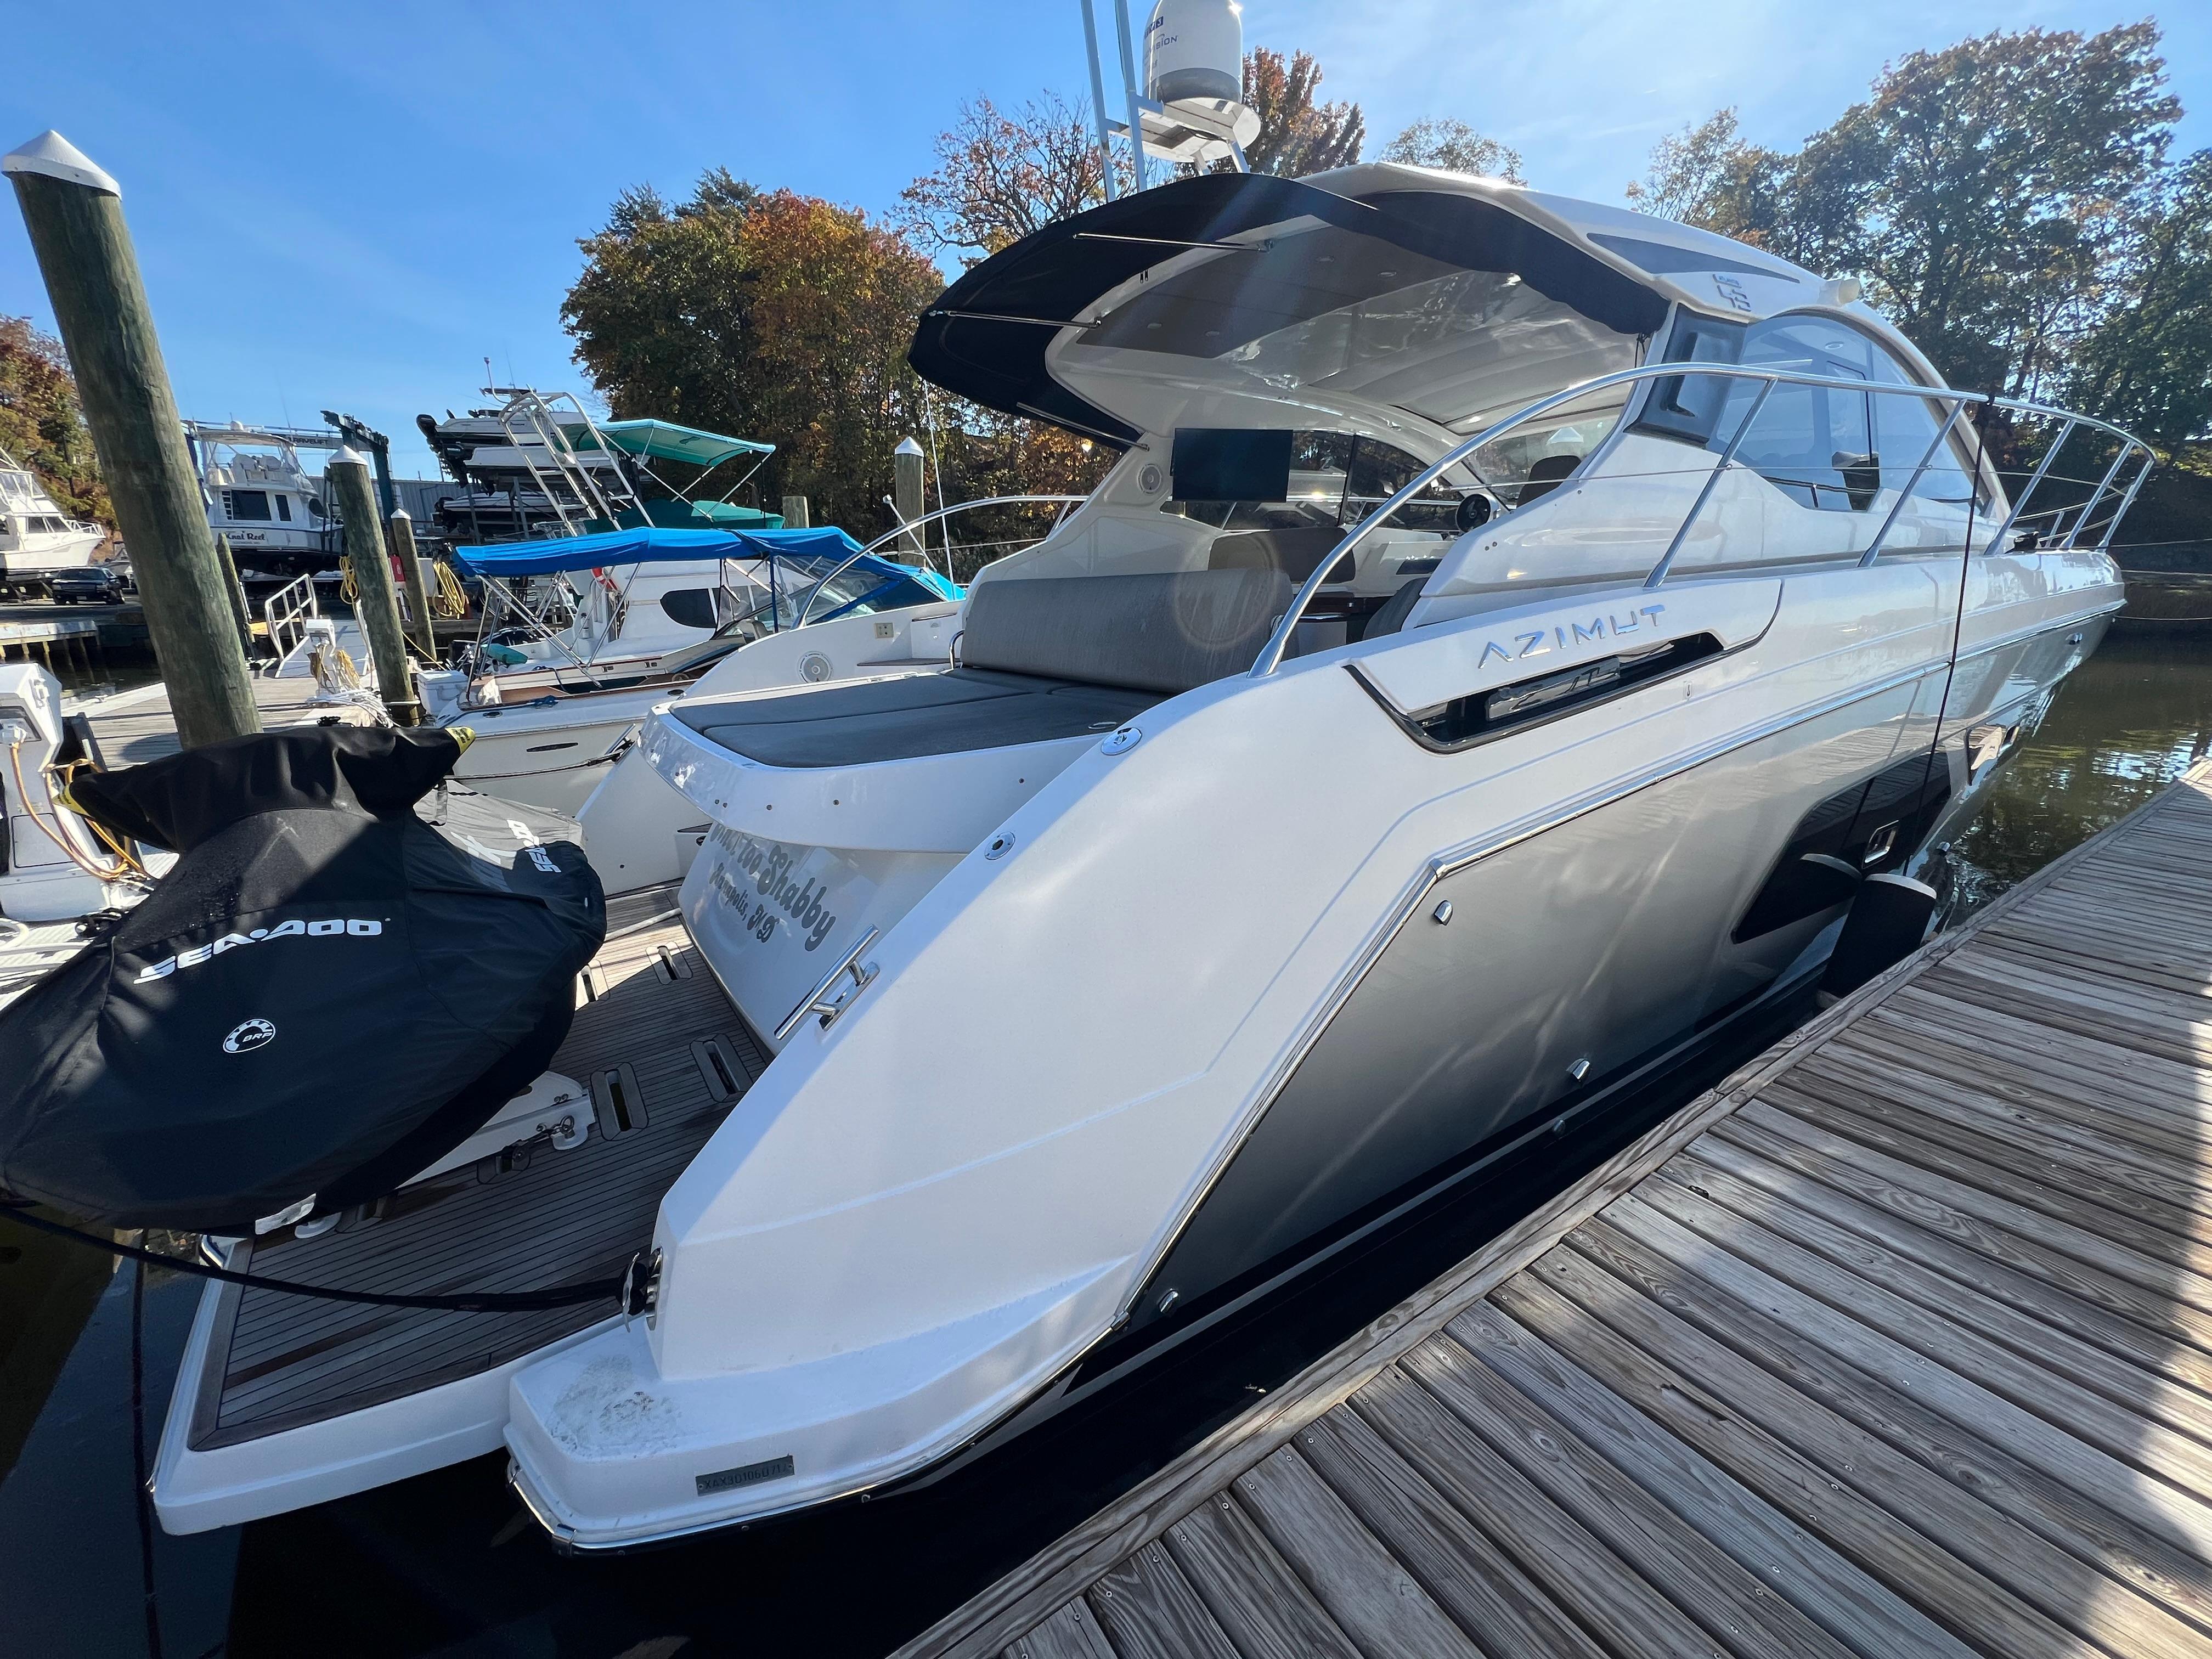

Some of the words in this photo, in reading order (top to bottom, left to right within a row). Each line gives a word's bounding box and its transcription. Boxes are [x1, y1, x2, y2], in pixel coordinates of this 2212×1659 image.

[1478, 604, 1666, 669] AZIMUT
[709, 862, 749, 922] Annapolis,
[757, 844, 836, 952] Shabby
[242, 1031, 275, 1043] BRP
